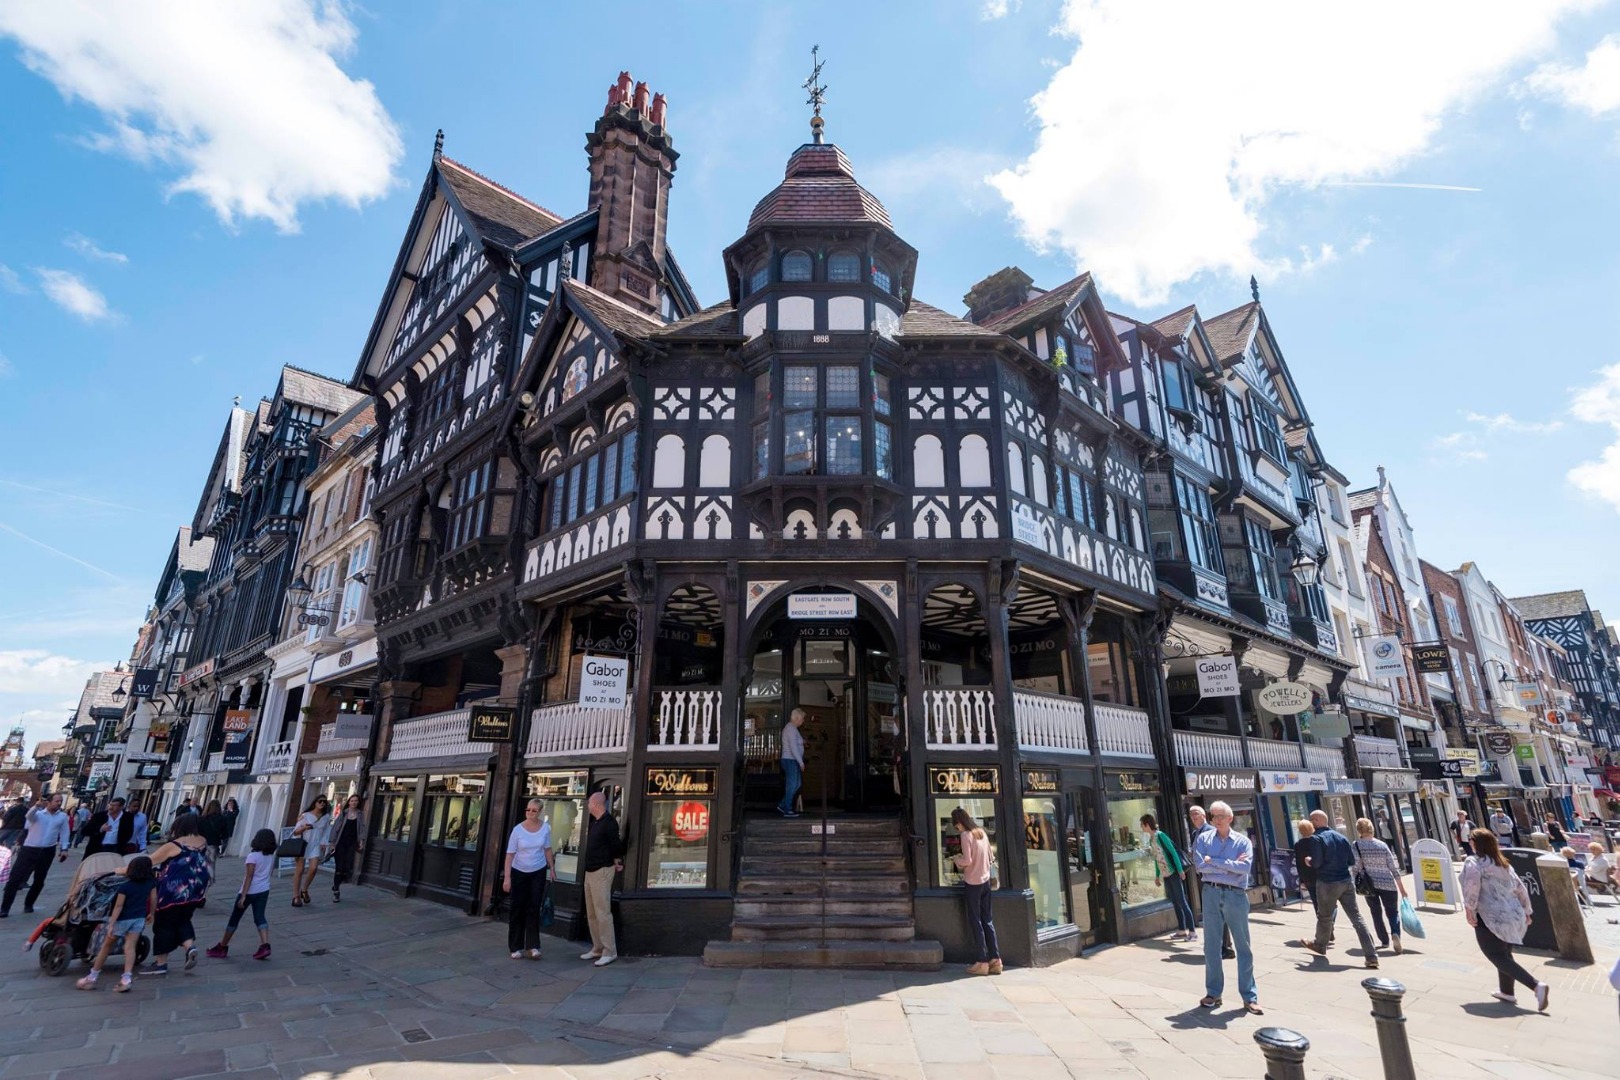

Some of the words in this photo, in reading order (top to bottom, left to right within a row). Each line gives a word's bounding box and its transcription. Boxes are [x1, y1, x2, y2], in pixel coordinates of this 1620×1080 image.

[813, 335, 830, 343] 1888
[800, 628, 815, 636] MO
[818, 628, 830, 636] ZI
[834, 628, 850, 636] MO
[1019, 642, 1033, 653] ZI
[1035, 640, 1055, 651] MO
[1416, 651, 1447, 660] LOWE
[586, 661, 625, 677] Gabor
[1199, 662, 1232, 673] Gabor
[137, 684, 150, 692] W
[592, 679, 616, 688] SHOES
[1263, 687, 1308, 702] POWELLS
[584, 695, 598, 704] MO
[1269, 700, 1303, 708] JEWELLERS
[226, 716, 245, 724] LAKE
[224, 721, 247, 730] LAND
[655, 773, 709, 791] Waltons
[937, 772, 992, 792] Waltons
[1199, 774, 1228, 790] LOTUS
[1230, 775, 1255, 789] diamond
[675, 812, 707, 831] SALE
